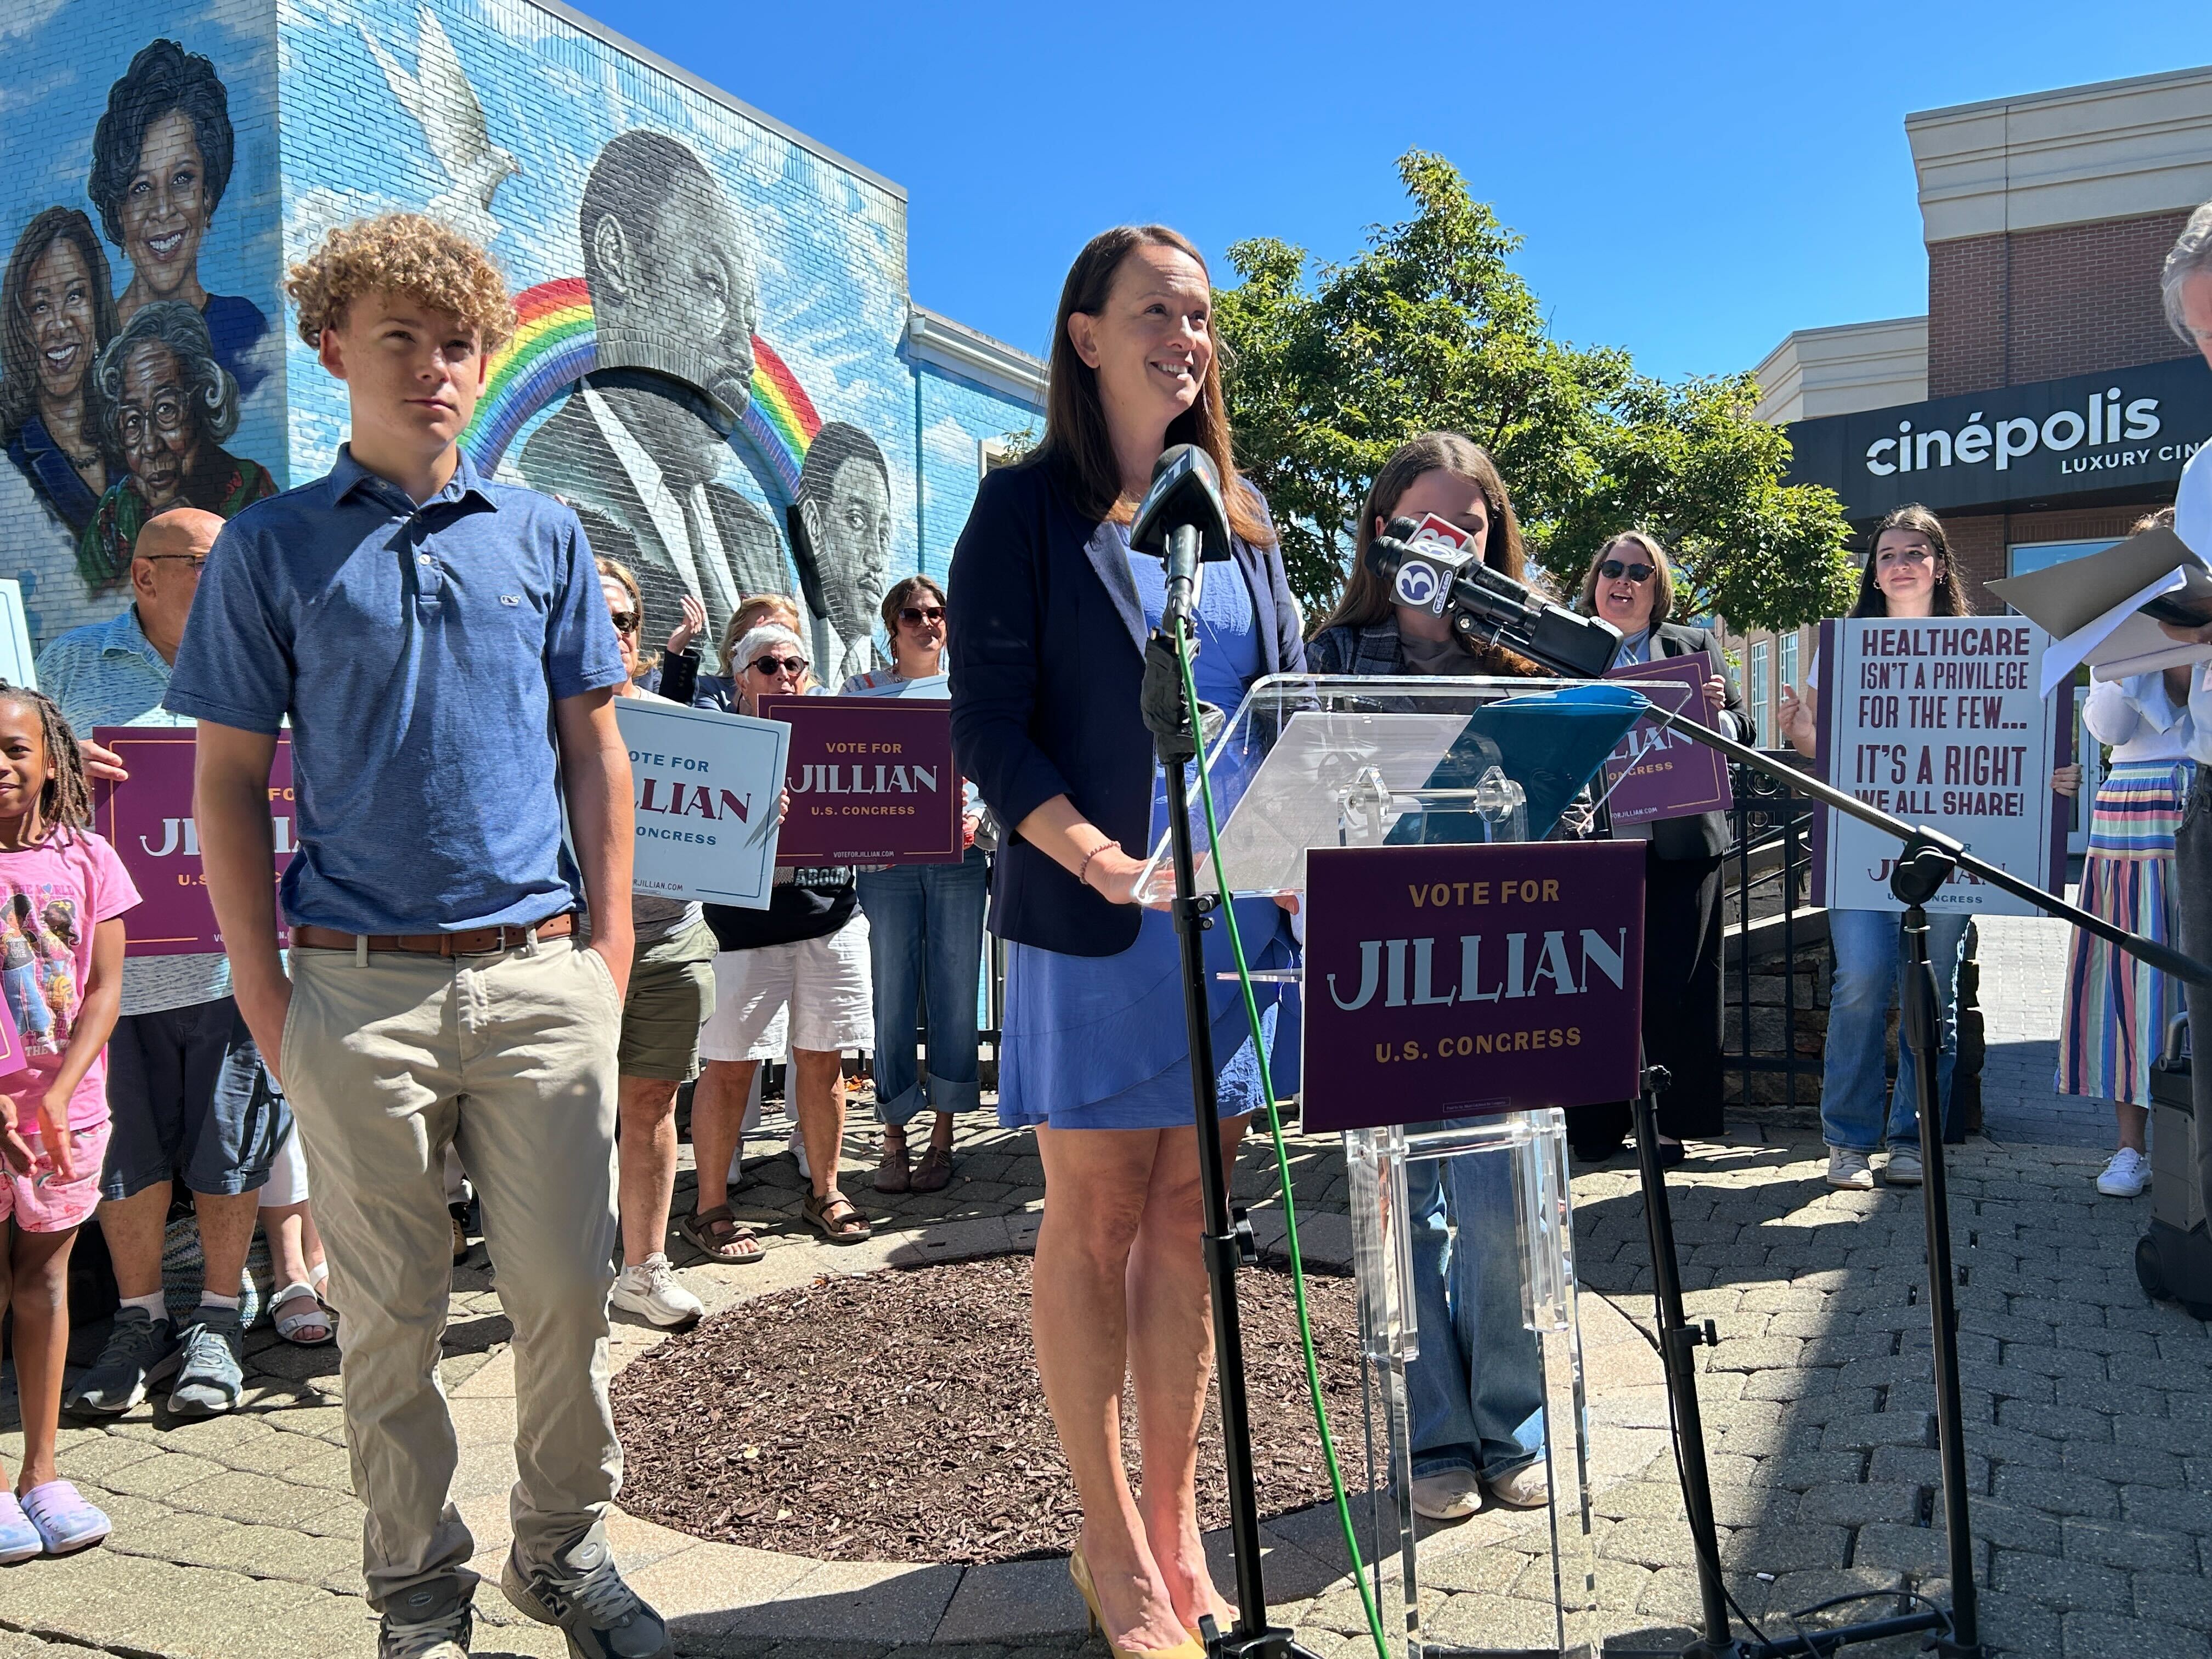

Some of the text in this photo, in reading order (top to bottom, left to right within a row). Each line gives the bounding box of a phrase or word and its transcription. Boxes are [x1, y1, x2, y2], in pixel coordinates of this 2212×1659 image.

[1866, 387, 2160, 476] cinépolis
[2061, 442, 2199, 474] LUXURY CIN
[1435, 573, 1451, 611] wfsb.com
[1862, 628, 2030, 657] HEALTHCARE
[1860, 662, 2028, 690] ISN'T A PRIVILEGE
[1859, 695, 2027, 730] FOR THE FEW...
[629, 751, 709, 772] OTE FOR
[826, 742, 902, 754] VOTE FOR
[787, 764, 938, 794] JILLIAN
[1609, 761, 1673, 781] OGRESS
[1856, 744, 2027, 786] IT'S A RIGHT
[268, 787, 294, 802] FO
[635, 778, 751, 824] LIAN
[1895, 791, 1937, 814] ALL
[1943, 791, 2024, 816] SHARE!
[811, 805, 915, 816] U.S. CONGRESS
[1611, 806, 1658, 819] FORJILLIAN.COM
[635, 826, 716, 845] ONGRESS
[633, 879, 683, 891] RJILLIAN.COM
[794, 867, 846, 887] ABOUT
[1408, 879, 1560, 907] VOTE FOR
[1931, 895, 1983, 904] NGRESS
[1326, 927, 1627, 1011] JILLIAN
[1375, 1026, 1582, 1063] U.S. CONGRESS
